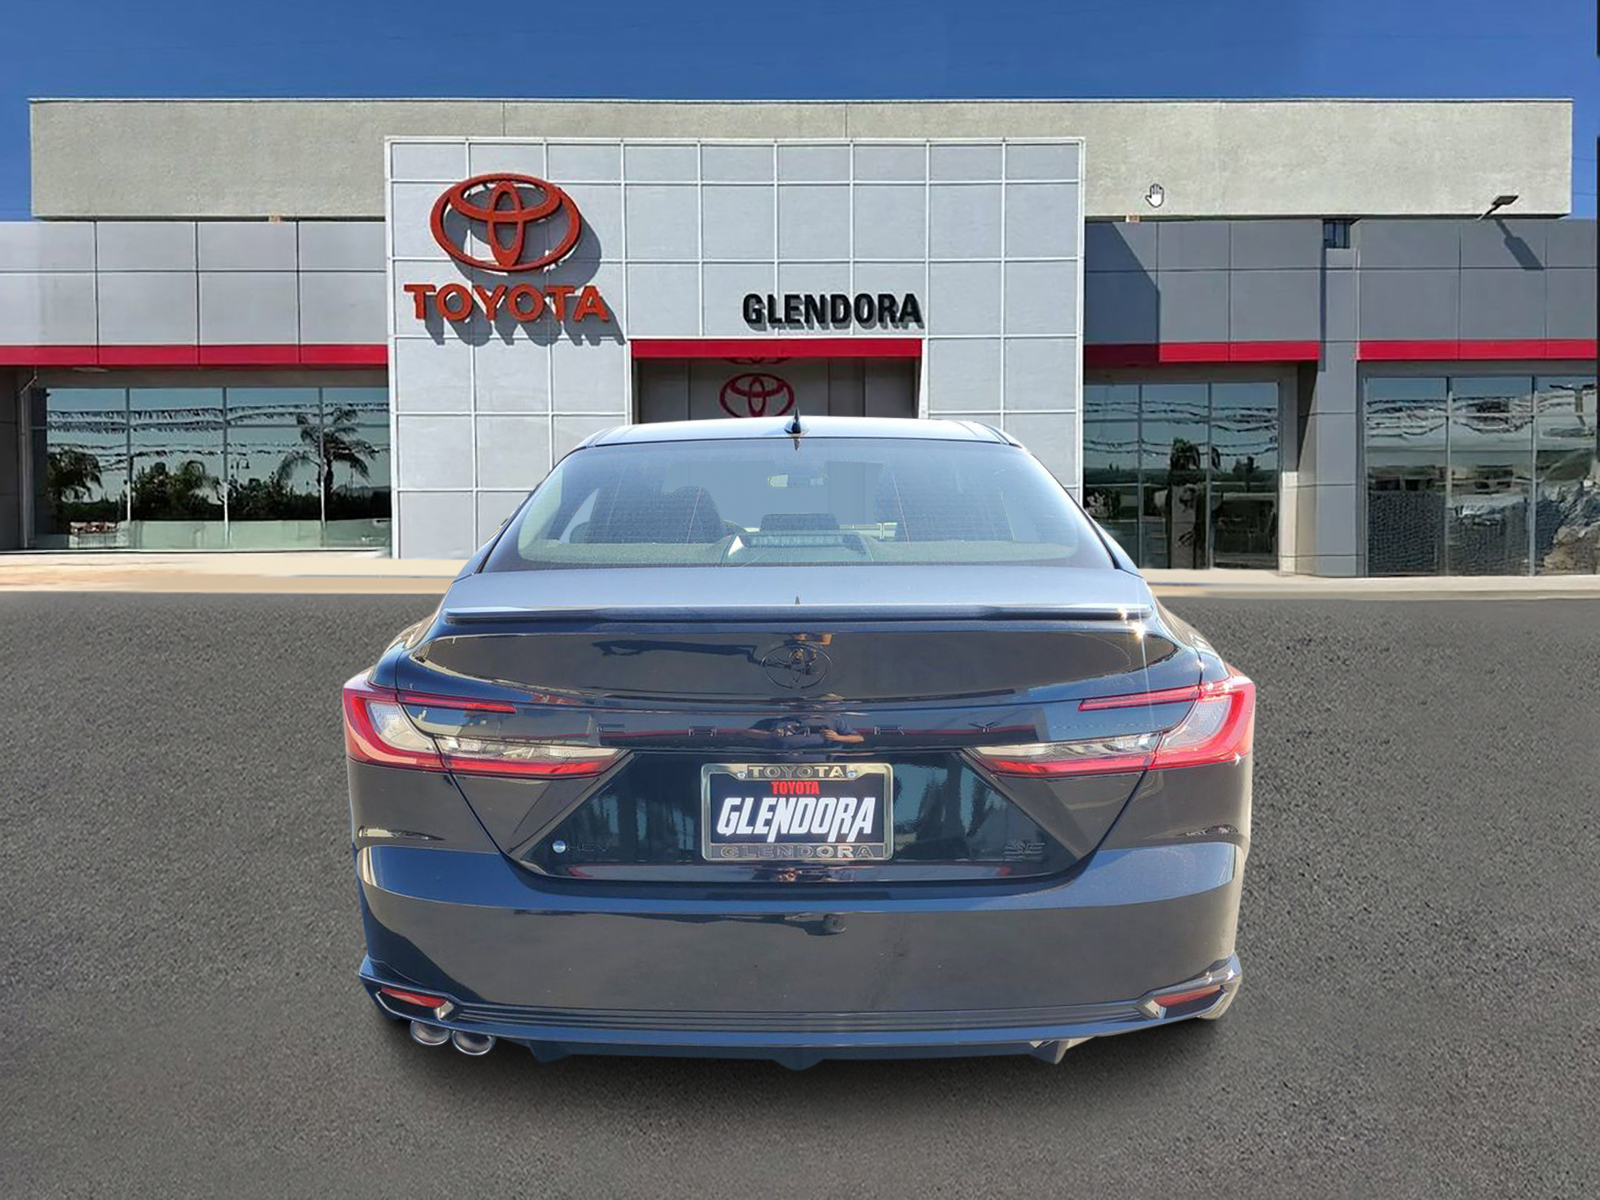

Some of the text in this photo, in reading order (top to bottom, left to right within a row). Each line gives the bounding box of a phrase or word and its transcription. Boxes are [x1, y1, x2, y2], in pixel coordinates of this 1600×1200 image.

[404, 283, 610, 322] TOYOTA
[743, 293, 922, 325] GLENDORA
[749, 766, 845, 778] TOYOTA
[771, 781, 819, 795] TOYOTA
[716, 797, 876, 843] GLENDORA
[720, 846, 874, 858] GLENDORA
